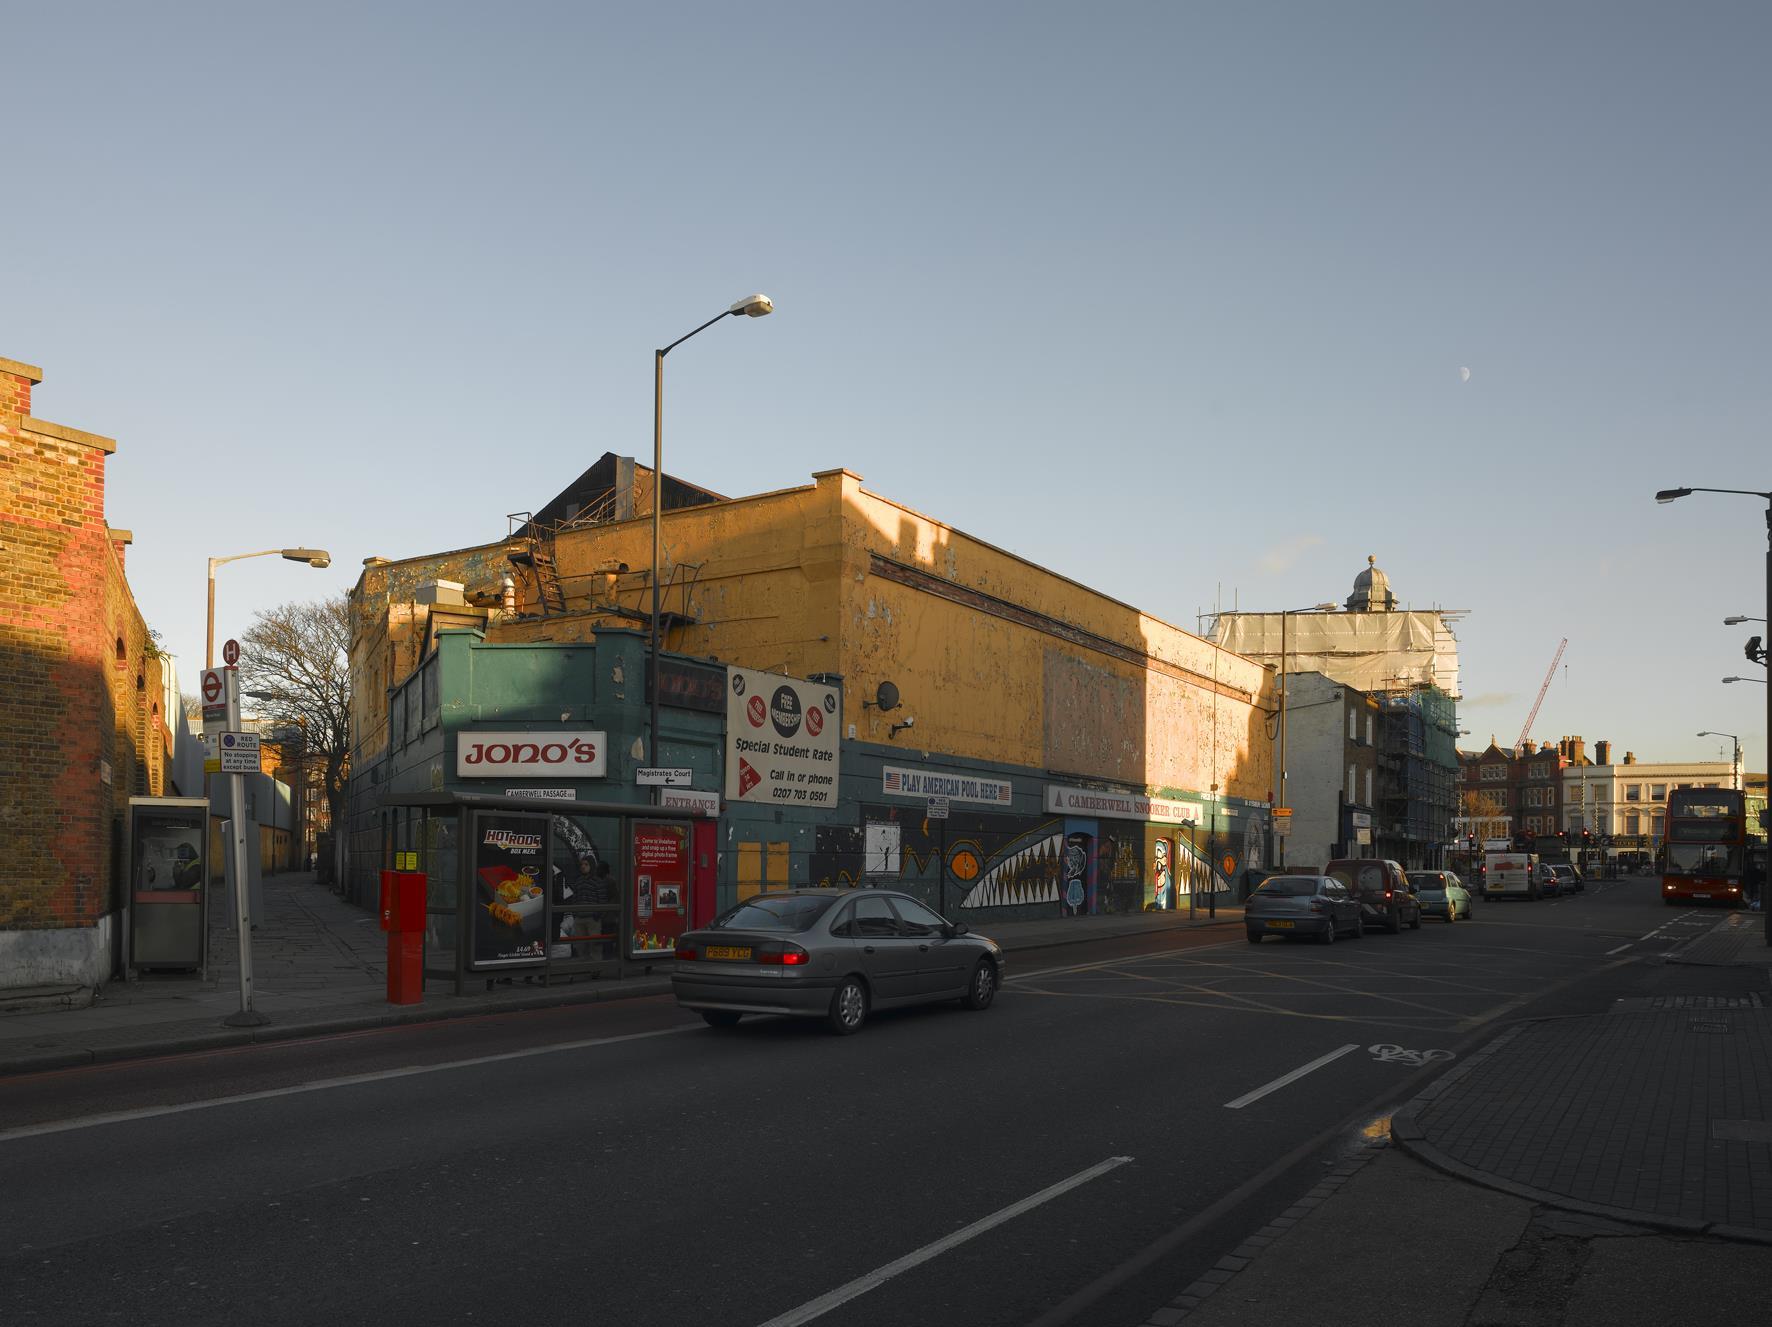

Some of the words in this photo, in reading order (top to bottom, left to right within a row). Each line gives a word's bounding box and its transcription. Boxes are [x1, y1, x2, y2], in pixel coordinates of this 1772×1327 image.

[736, 737, 770, 754] Special
[773, 743, 810, 758] Student
[812, 749, 833, 762] Rate
[637, 769, 673, 778] Magistrates
[674, 770, 691, 778] Court
[770, 770, 785, 781] Call
[786, 771, 795, 782] in
[797, 774, 806, 784] or
[807, 774, 833, 786] phone
[507, 790, 541, 798] CAMBERWELL
[543, 790, 567, 798] PASSAGE
[773, 788, 792, 800] 0207
[793, 790, 808, 801] 703
[809, 791, 828, 802] 0501
[902, 774, 921, 793] PLAY
[923, 776, 960, 797] AMERICAN
[961, 781, 979, 799] POOL
[980, 783, 998, 801] HERE
[665, 796, 716, 811] ENTRANCE
[1068, 795, 1132, 813] CAMBERWELL
[1134, 801, 1170, 818] SNOOKER
[1172, 807, 1191, 819] CLUB
